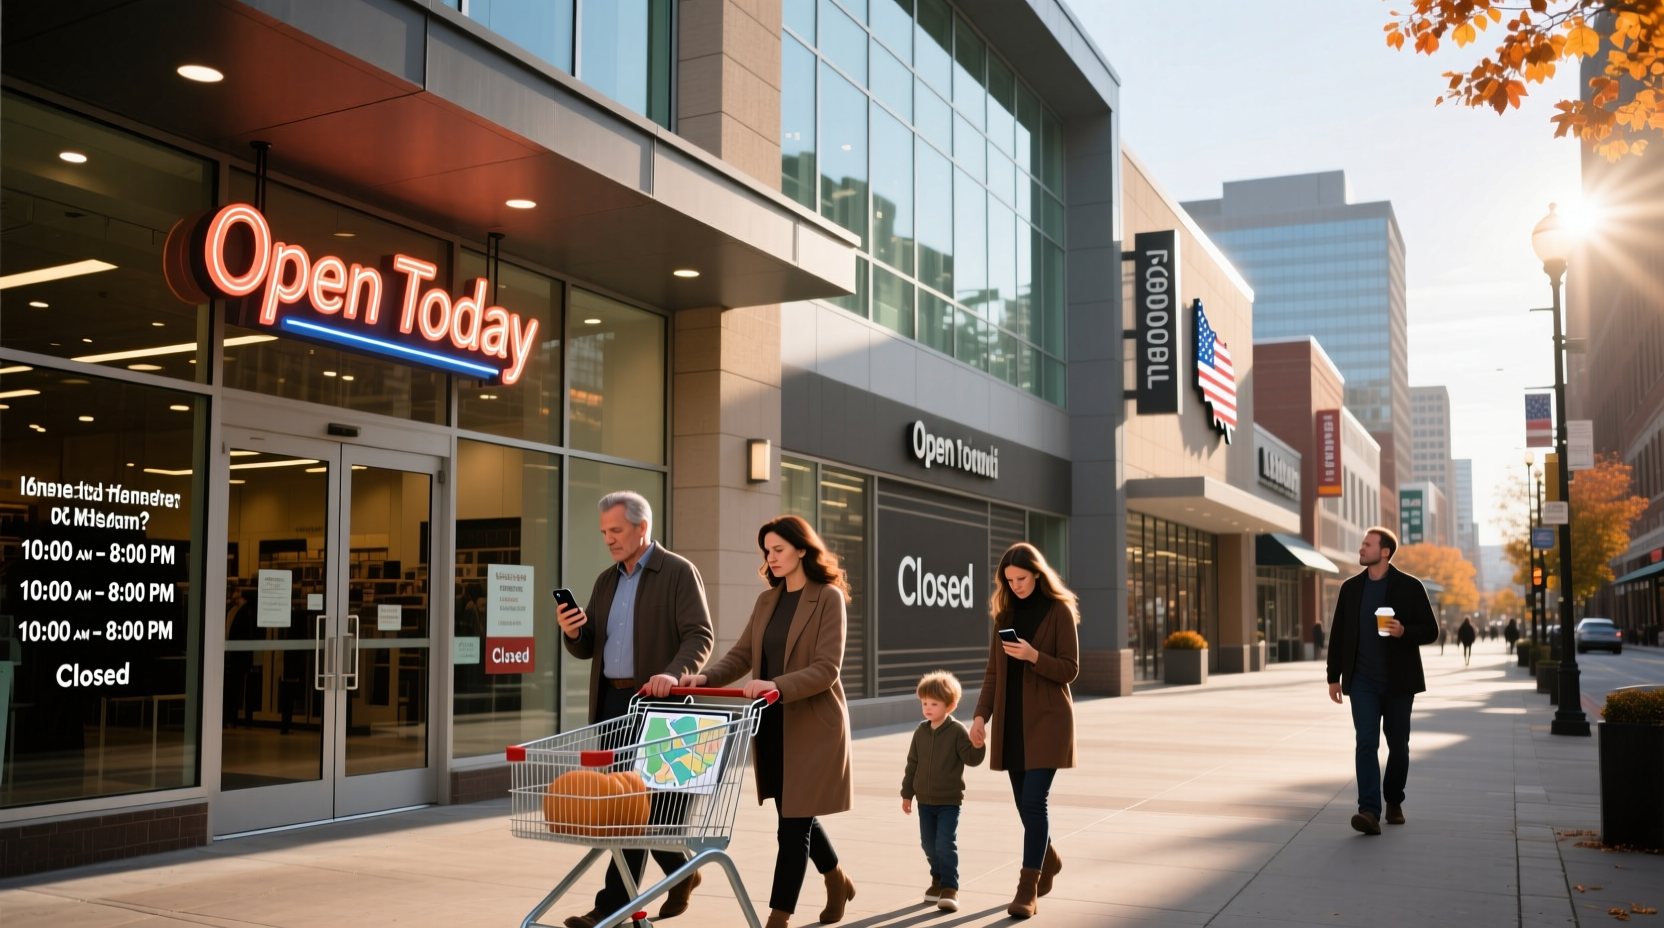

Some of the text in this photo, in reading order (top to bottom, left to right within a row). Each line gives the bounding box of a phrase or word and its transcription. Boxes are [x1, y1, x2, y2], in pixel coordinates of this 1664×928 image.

[204, 202, 540, 386] Open Today
[912, 419, 955, 469] Open
[21, 539, 73, 562] 10:00
[75, 549, 93, 561] AM
[109, 542, 147, 564] 8:00
[150, 544, 175, 565] PM
[19, 579, 73, 602] 10:00
[74, 589, 92, 601] AM
[107, 581, 146, 603] 8:00
[149, 582, 175, 603] PM
[897, 555, 974, 609] Closed
[18, 620, 71, 642] 10:00
[72, 628, 90, 642] AM
[105, 620, 144, 641] 8:00
[147, 620, 173, 640] PM
[55, 661, 130, 688] Closed
